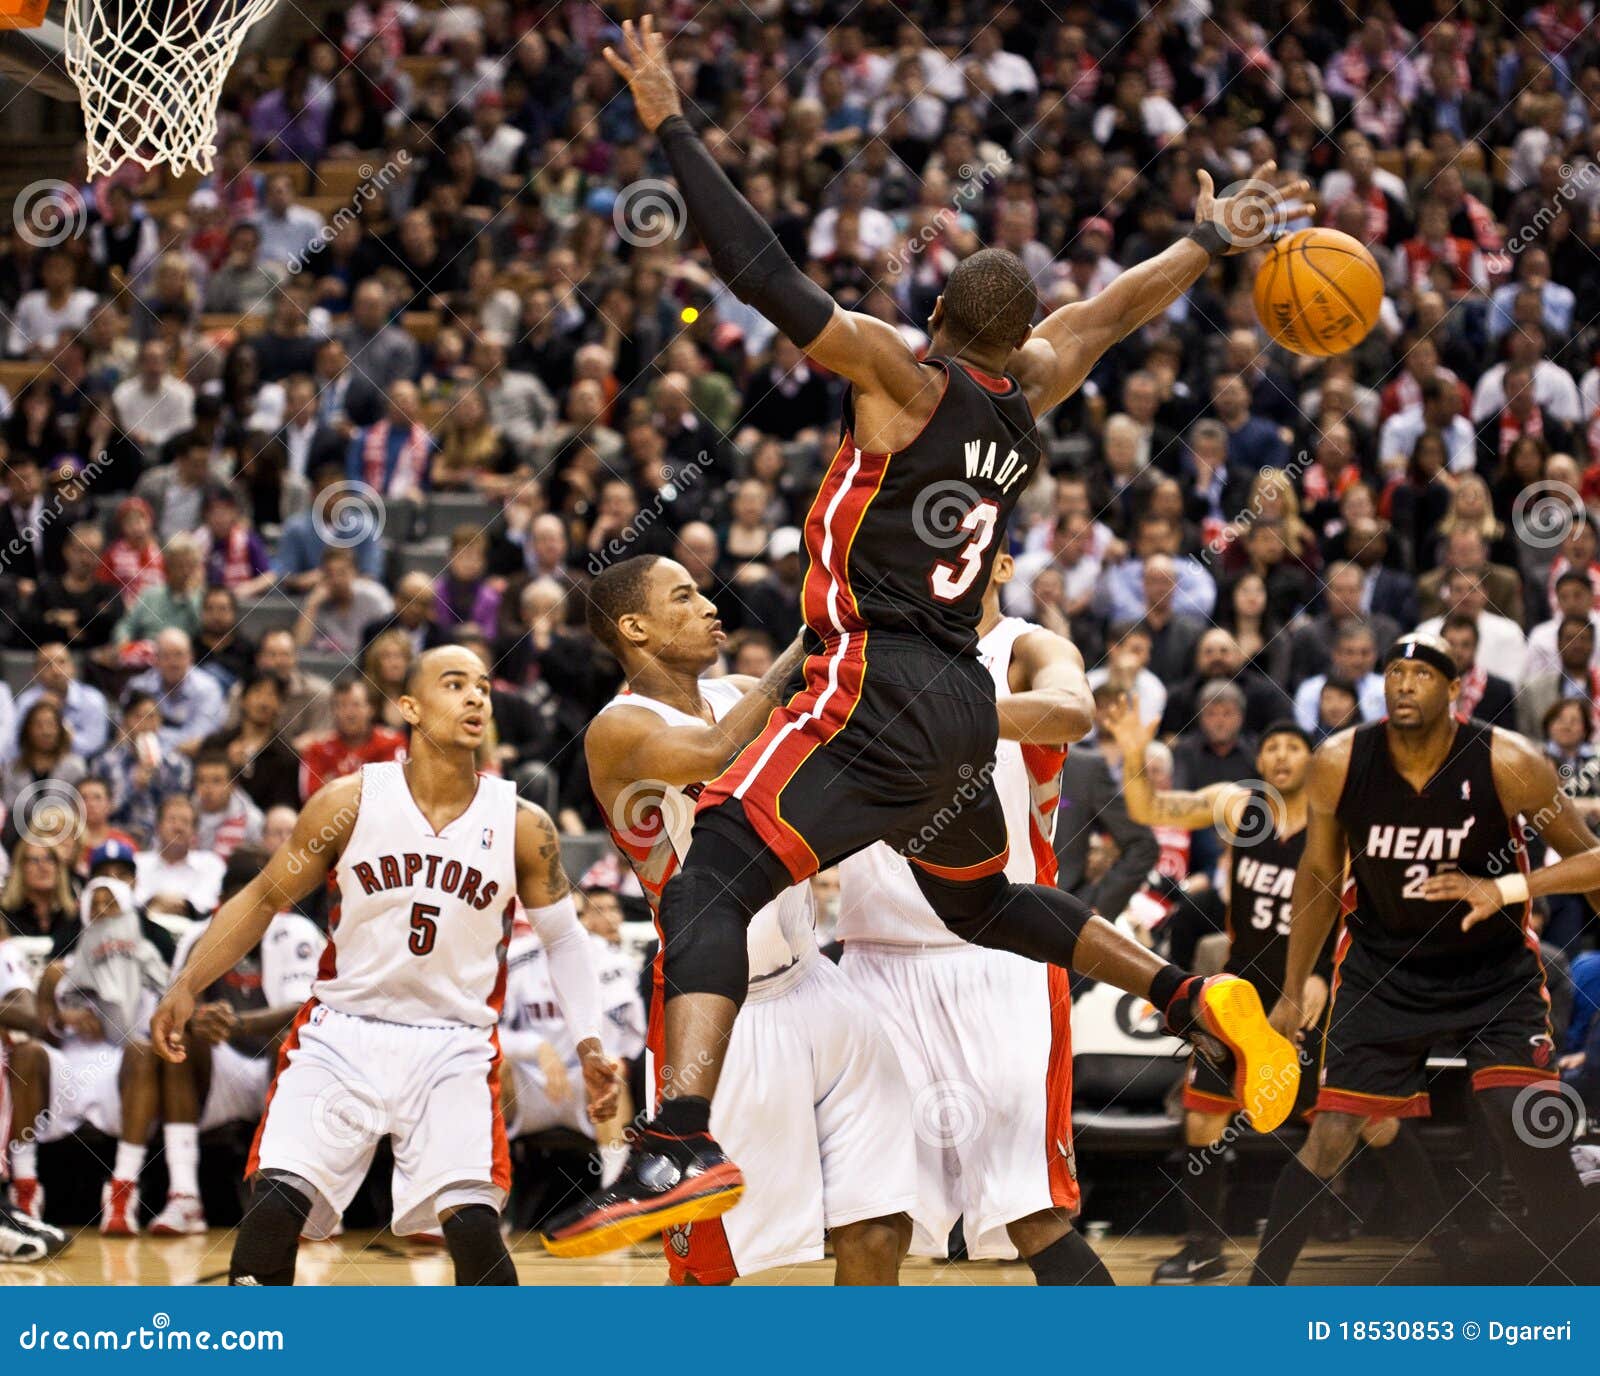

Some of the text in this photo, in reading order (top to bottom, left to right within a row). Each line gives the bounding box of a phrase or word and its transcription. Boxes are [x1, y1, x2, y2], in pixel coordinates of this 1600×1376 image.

[928, 497, 1001, 605] 3
[1366, 815, 1476, 860] HEAT
[352, 853, 499, 911] RAPTORS
[1236, 856, 1296, 899] HEA
[1402, 862, 1458, 899] 2
[408, 902, 441, 957] 5
